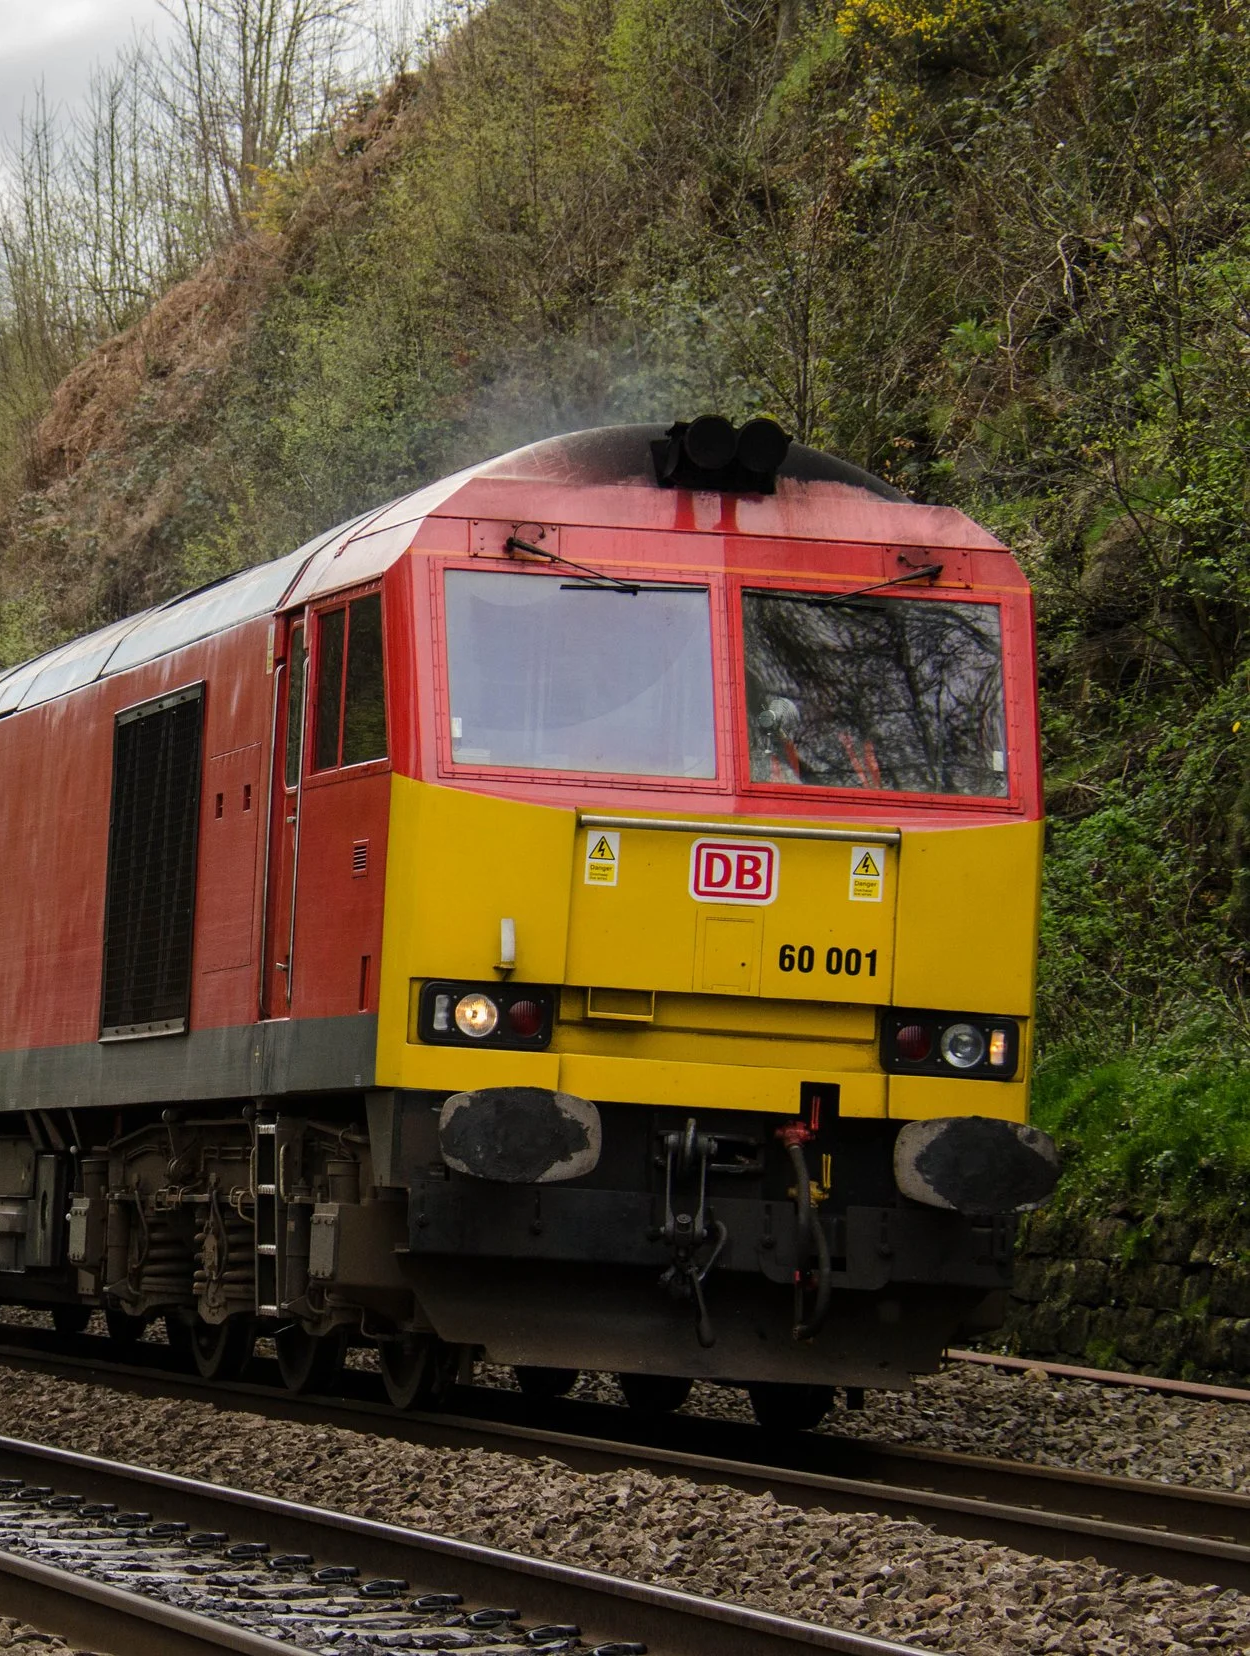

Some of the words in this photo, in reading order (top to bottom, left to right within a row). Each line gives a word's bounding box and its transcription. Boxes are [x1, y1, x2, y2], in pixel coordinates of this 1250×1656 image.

[590, 864, 613, 873] Danger
[703, 852, 763, 891] DB
[854, 880, 878, 889] Danger
[778, 944, 815, 974] 60
[825, 947, 877, 977] 001
